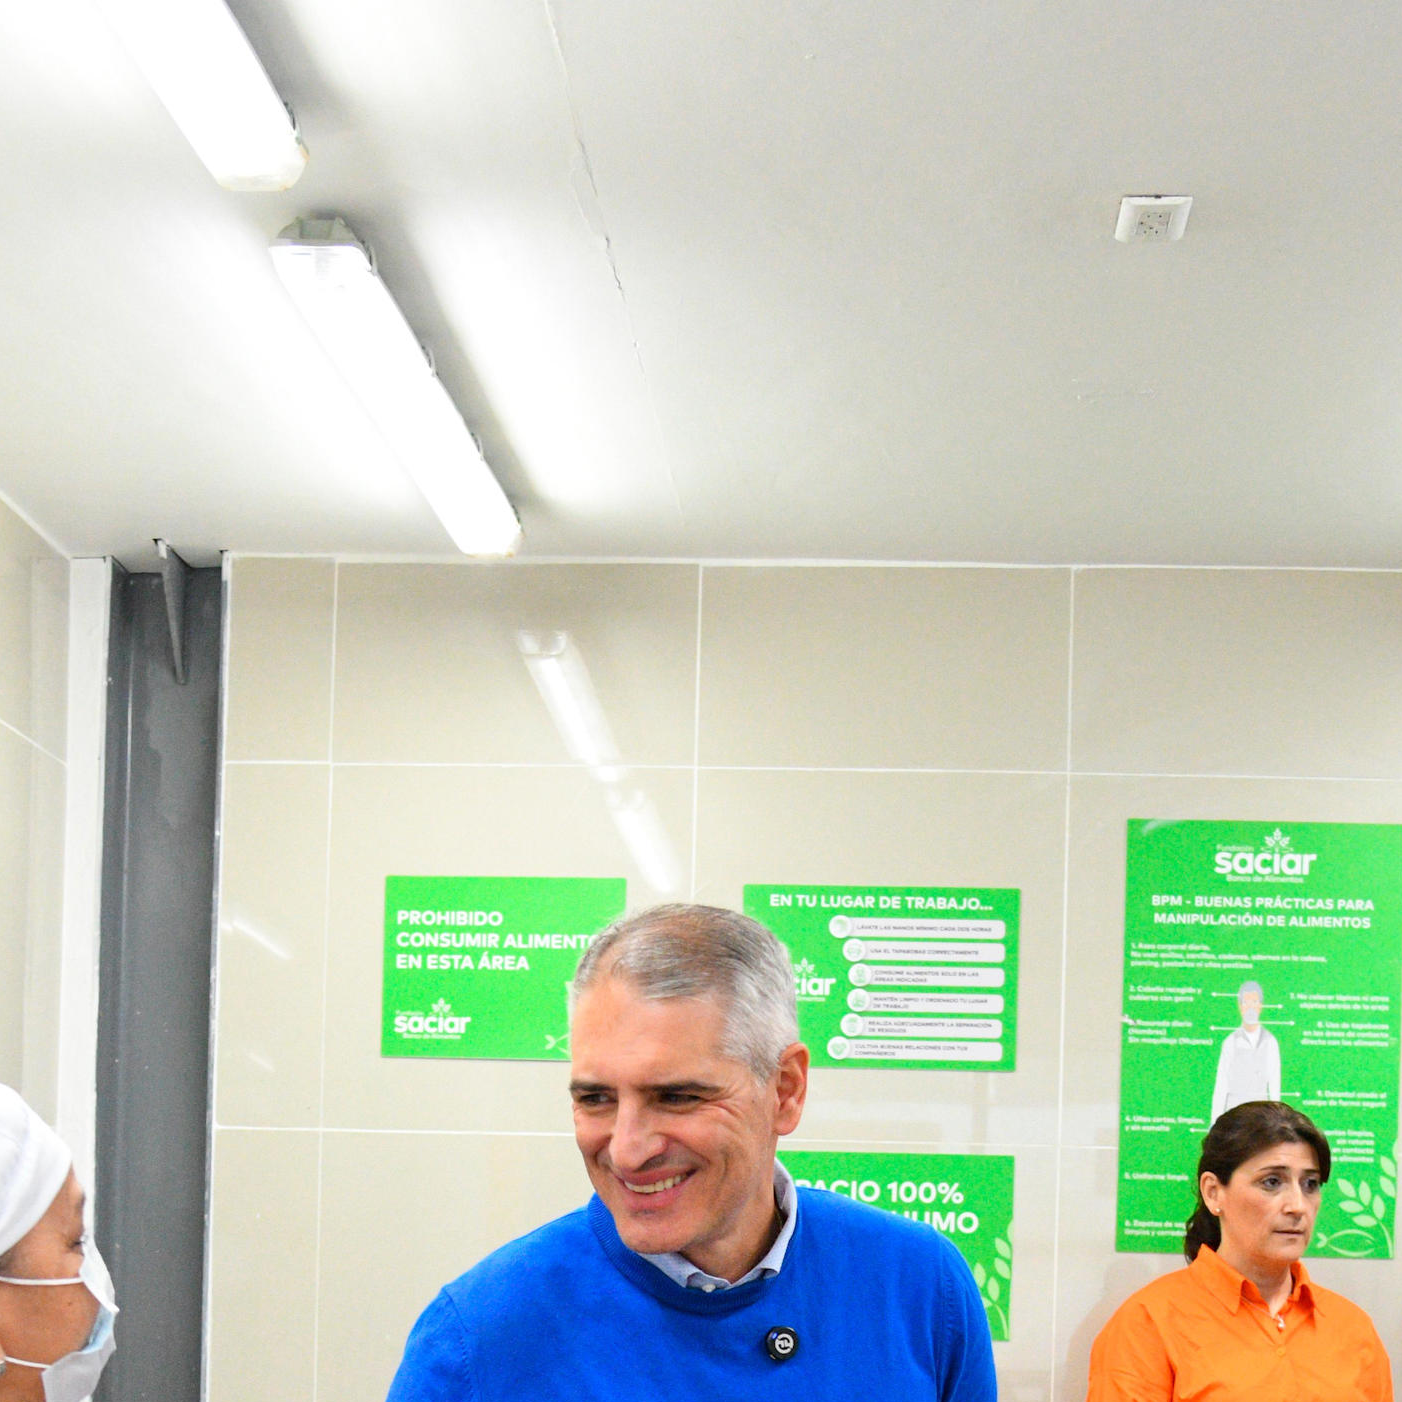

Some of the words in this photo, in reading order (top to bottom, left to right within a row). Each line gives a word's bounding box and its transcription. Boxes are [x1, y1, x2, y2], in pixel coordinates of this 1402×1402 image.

[1214, 850, 1318, 875] saciar
[770, 894, 792, 907] EN
[795, 895, 817, 907] TU
[821, 895, 875, 908] LUGAR
[879, 896, 902, 909] DE
[905, 897, 994, 910] TRABAJO...
[1151, 895, 1182, 906] BPM
[1195, 896, 1252, 908] BUENAS
[1256, 895, 1334, 910] PRÁCTICAS
[1337, 899, 1375, 911] PARA
[397, 910, 503, 926] PROHIBIDO
[1154, 912, 1264, 927] MANIPULACIÓN
[1267, 915, 1285, 926] DE
[1289, 916, 1371, 928] ALIMENTOS
[396, 932, 499, 948] CONSUMIR
[396, 954, 422, 969] EN
[427, 954, 474, 970] ESTA
[477, 951, 530, 970] ÁREA
[394, 1013, 472, 1034] saciar
[887, 1181, 965, 1204] 100%
